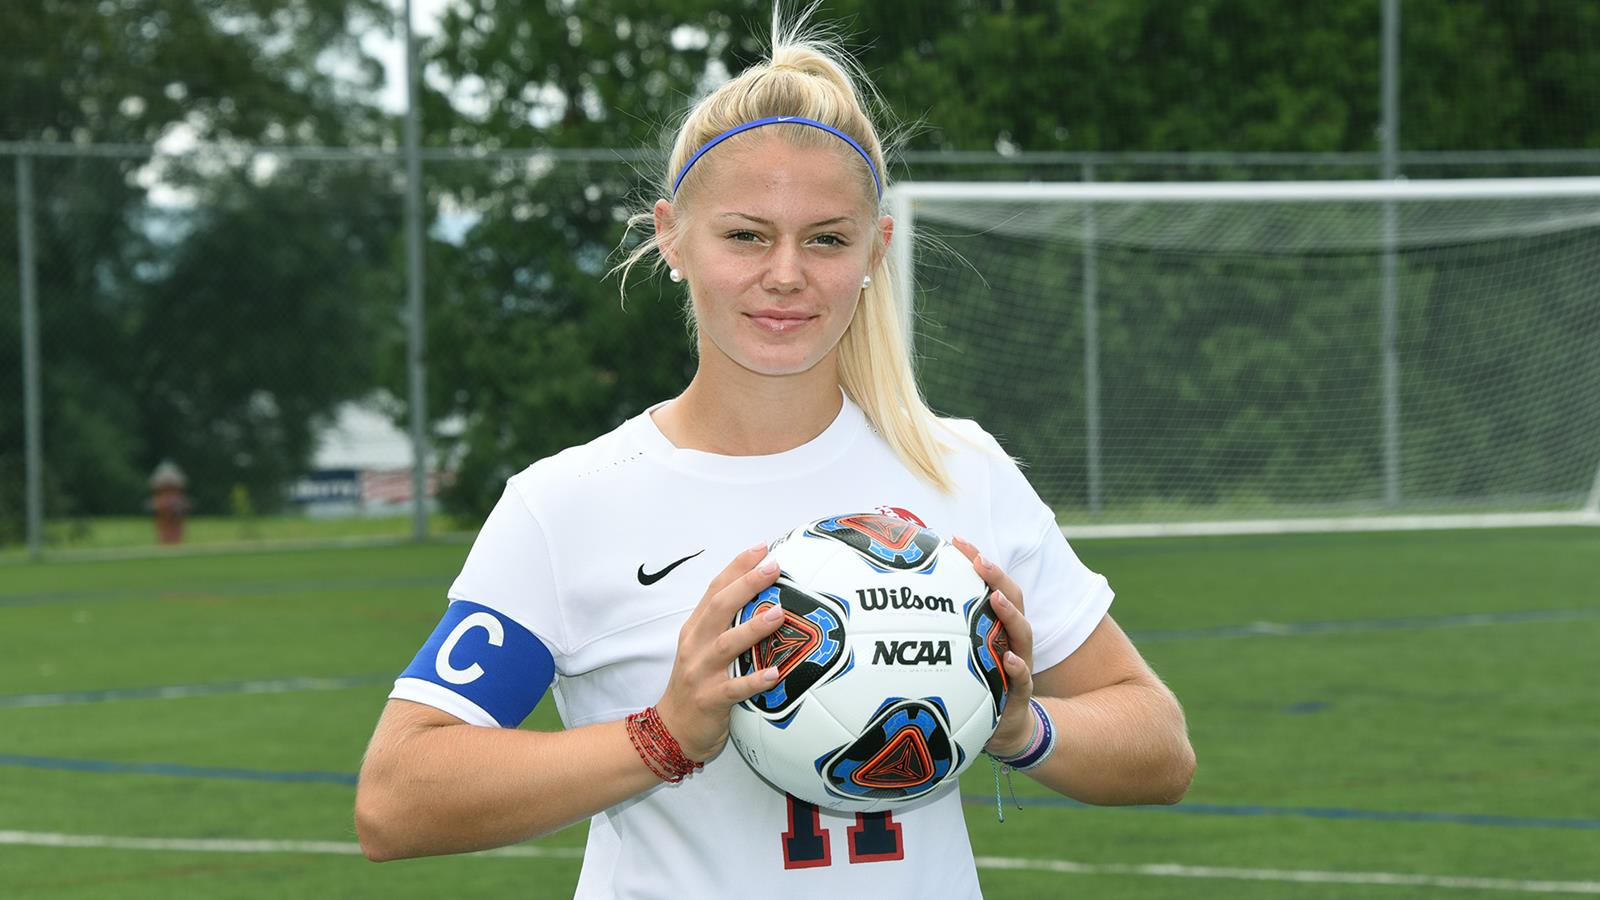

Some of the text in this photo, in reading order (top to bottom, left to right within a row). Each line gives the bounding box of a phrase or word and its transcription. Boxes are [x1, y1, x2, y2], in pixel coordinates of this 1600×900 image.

[856, 586, 957, 615] Wilson
[435, 611, 505, 685] C
[871, 640, 952, 666] NCAA
